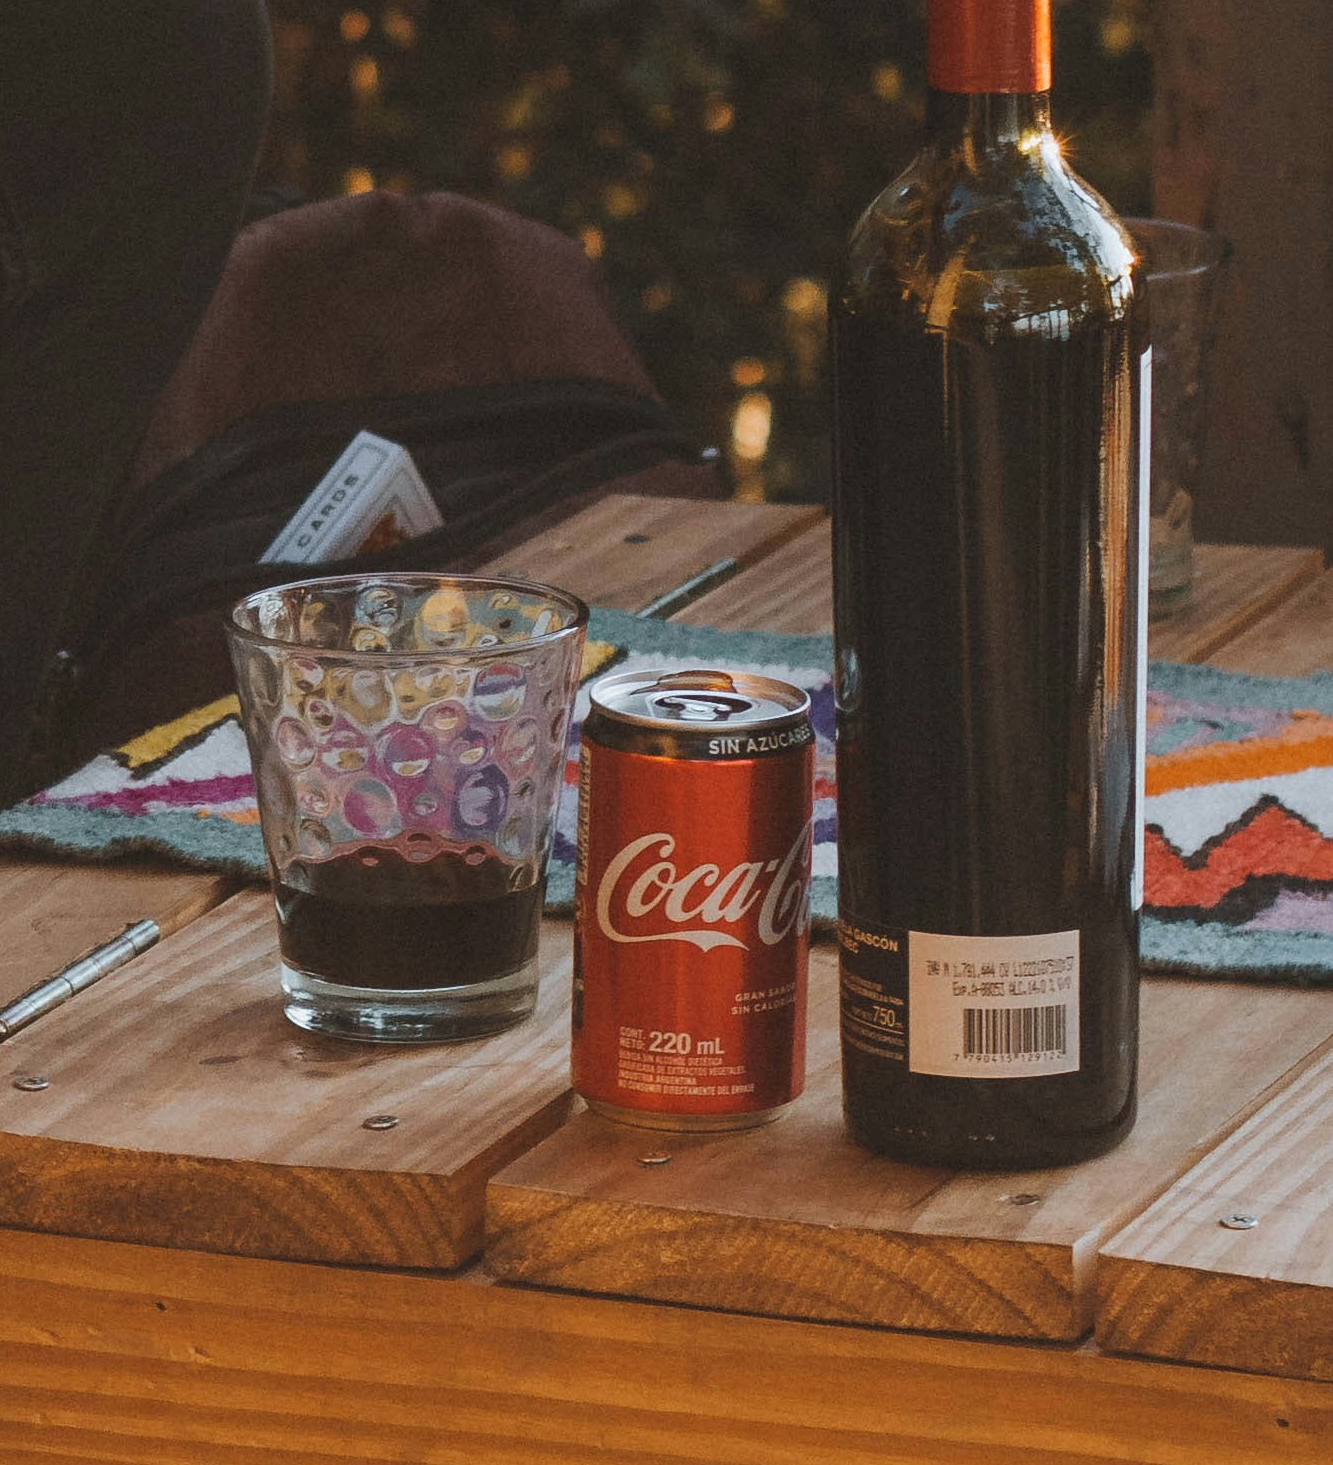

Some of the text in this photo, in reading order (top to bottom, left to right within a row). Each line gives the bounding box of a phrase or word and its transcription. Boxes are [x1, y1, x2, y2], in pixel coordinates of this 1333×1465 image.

[297, 474, 358, 548] CARDS
[709, 724, 811, 755] SIN AZÚCARES
[854, 928, 898, 952] GASCÓN
[731, 1005, 750, 1015] SIN
[873, 1005, 895, 1027] 750
[648, 1031, 725, 1055] 220 mL
